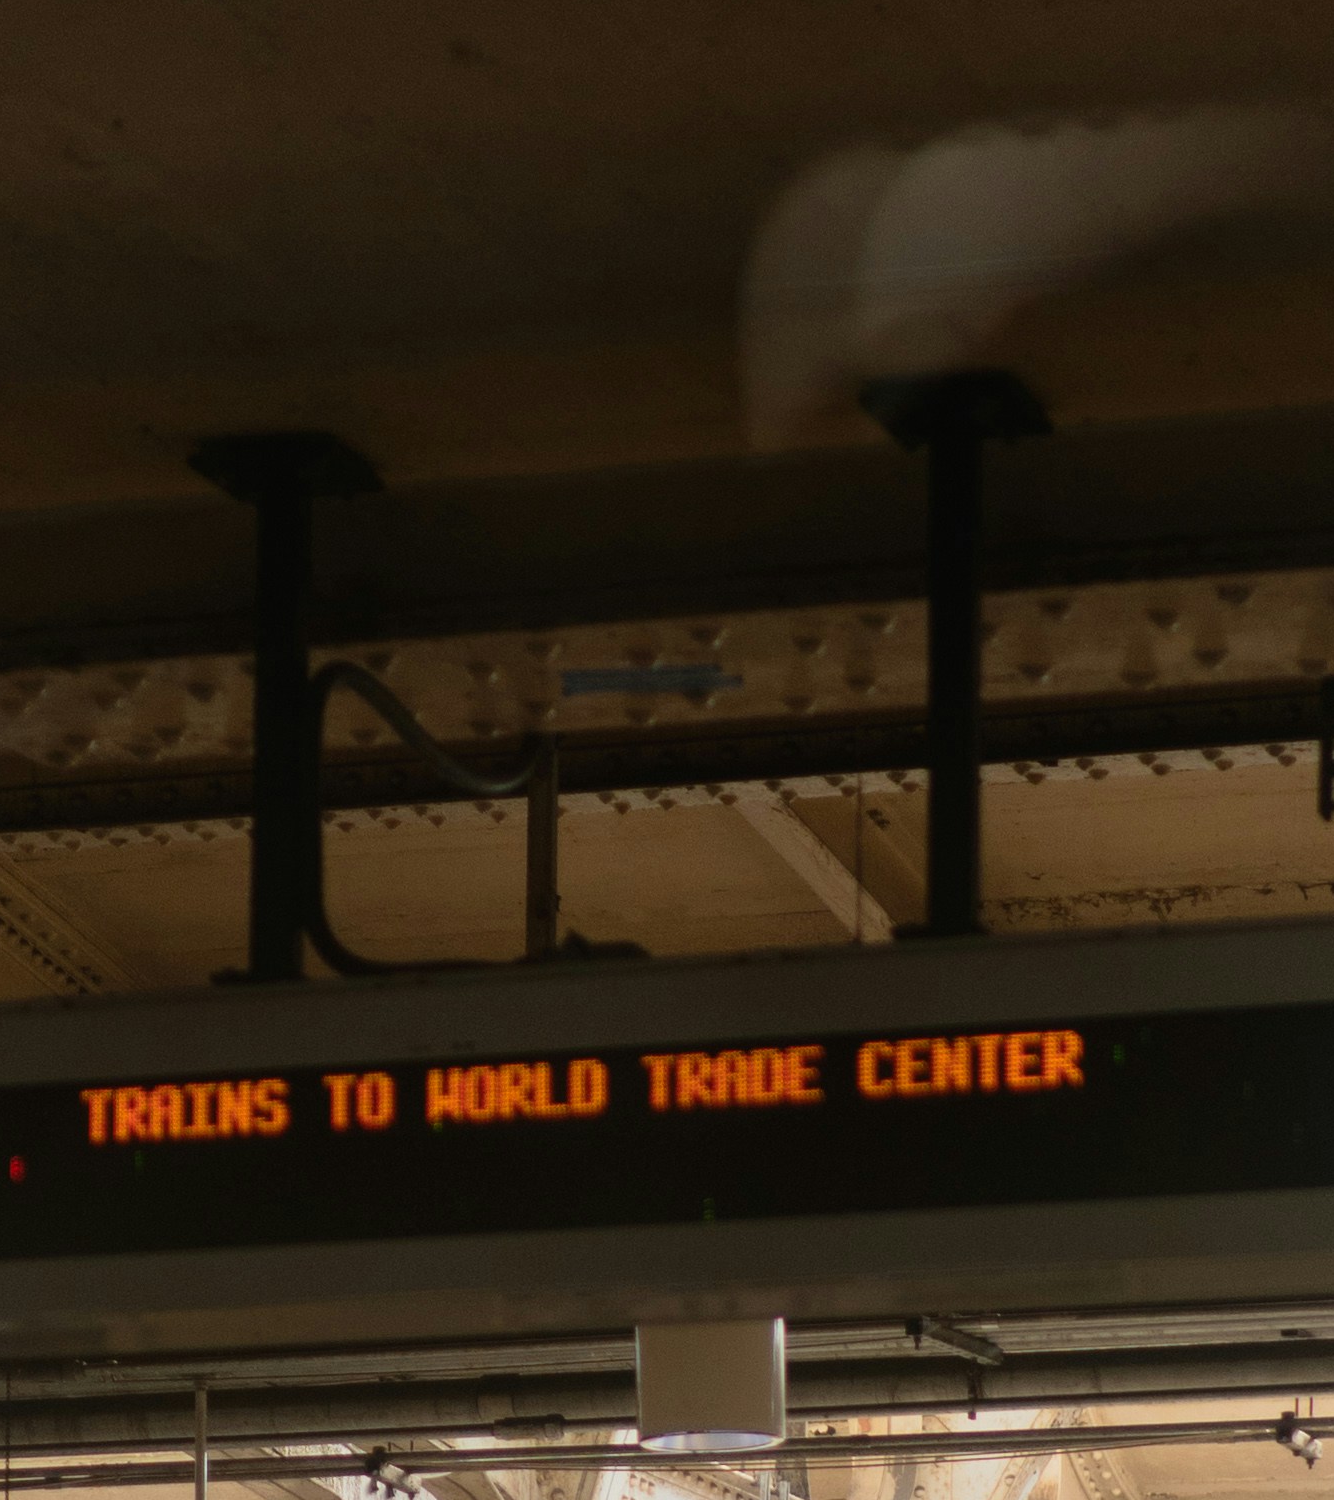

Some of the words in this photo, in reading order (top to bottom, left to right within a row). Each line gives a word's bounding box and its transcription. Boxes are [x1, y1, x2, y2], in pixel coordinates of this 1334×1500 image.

[79, 1077, 291, 1146] TRAINS
[322, 1070, 396, 1133] TO
[425, 1058, 610, 1126] WORLD
[639, 1043, 826, 1113] TRADE
[855, 1028, 1085, 1102] CENTER
